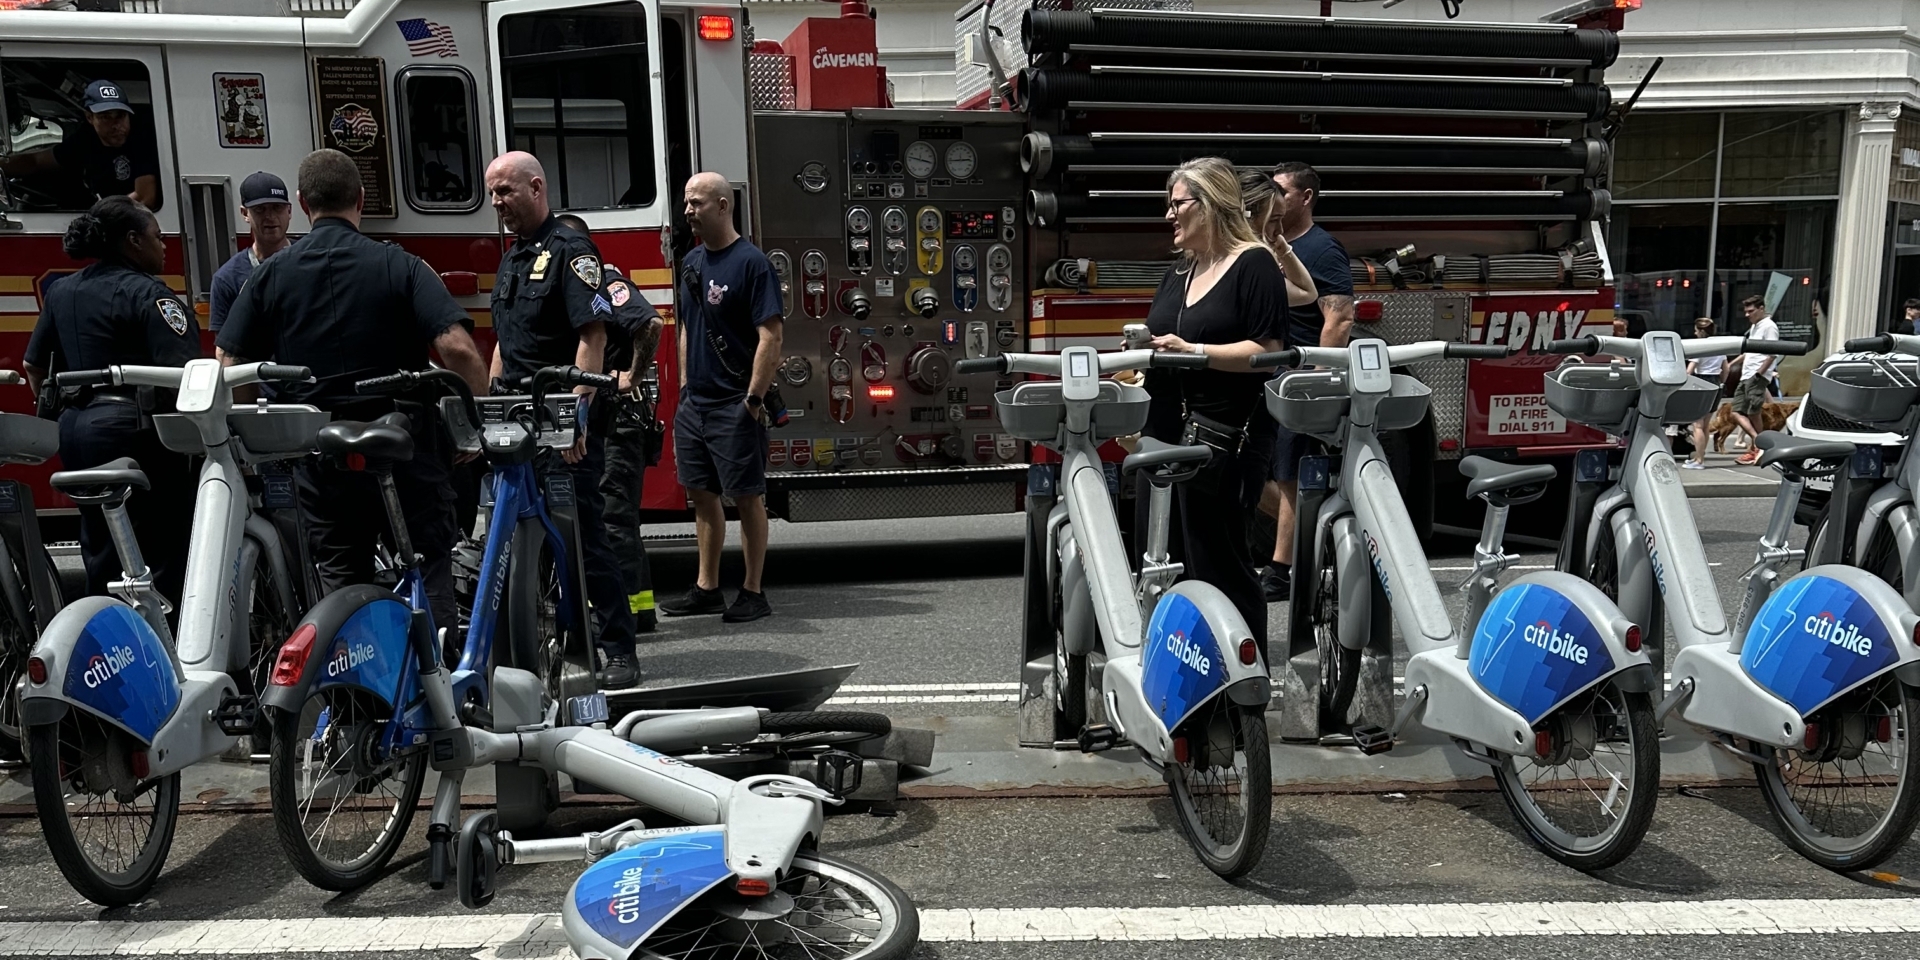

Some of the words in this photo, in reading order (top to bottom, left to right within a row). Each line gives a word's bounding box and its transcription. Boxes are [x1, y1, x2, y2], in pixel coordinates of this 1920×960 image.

[816, 46, 828, 55] THE
[812, 53, 874, 69] CAVEMEN
[103, 88, 116, 96] 40
[1486, 310, 1585, 351] FDNY
[1494, 397, 1511, 408] TO
[1514, 396, 1548, 407] REPO
[1508, 409, 1518, 420] A
[1521, 409, 1548, 419] FIRE
[1499, 422, 1529, 433] DIAL
[1532, 421, 1555, 432] 911
